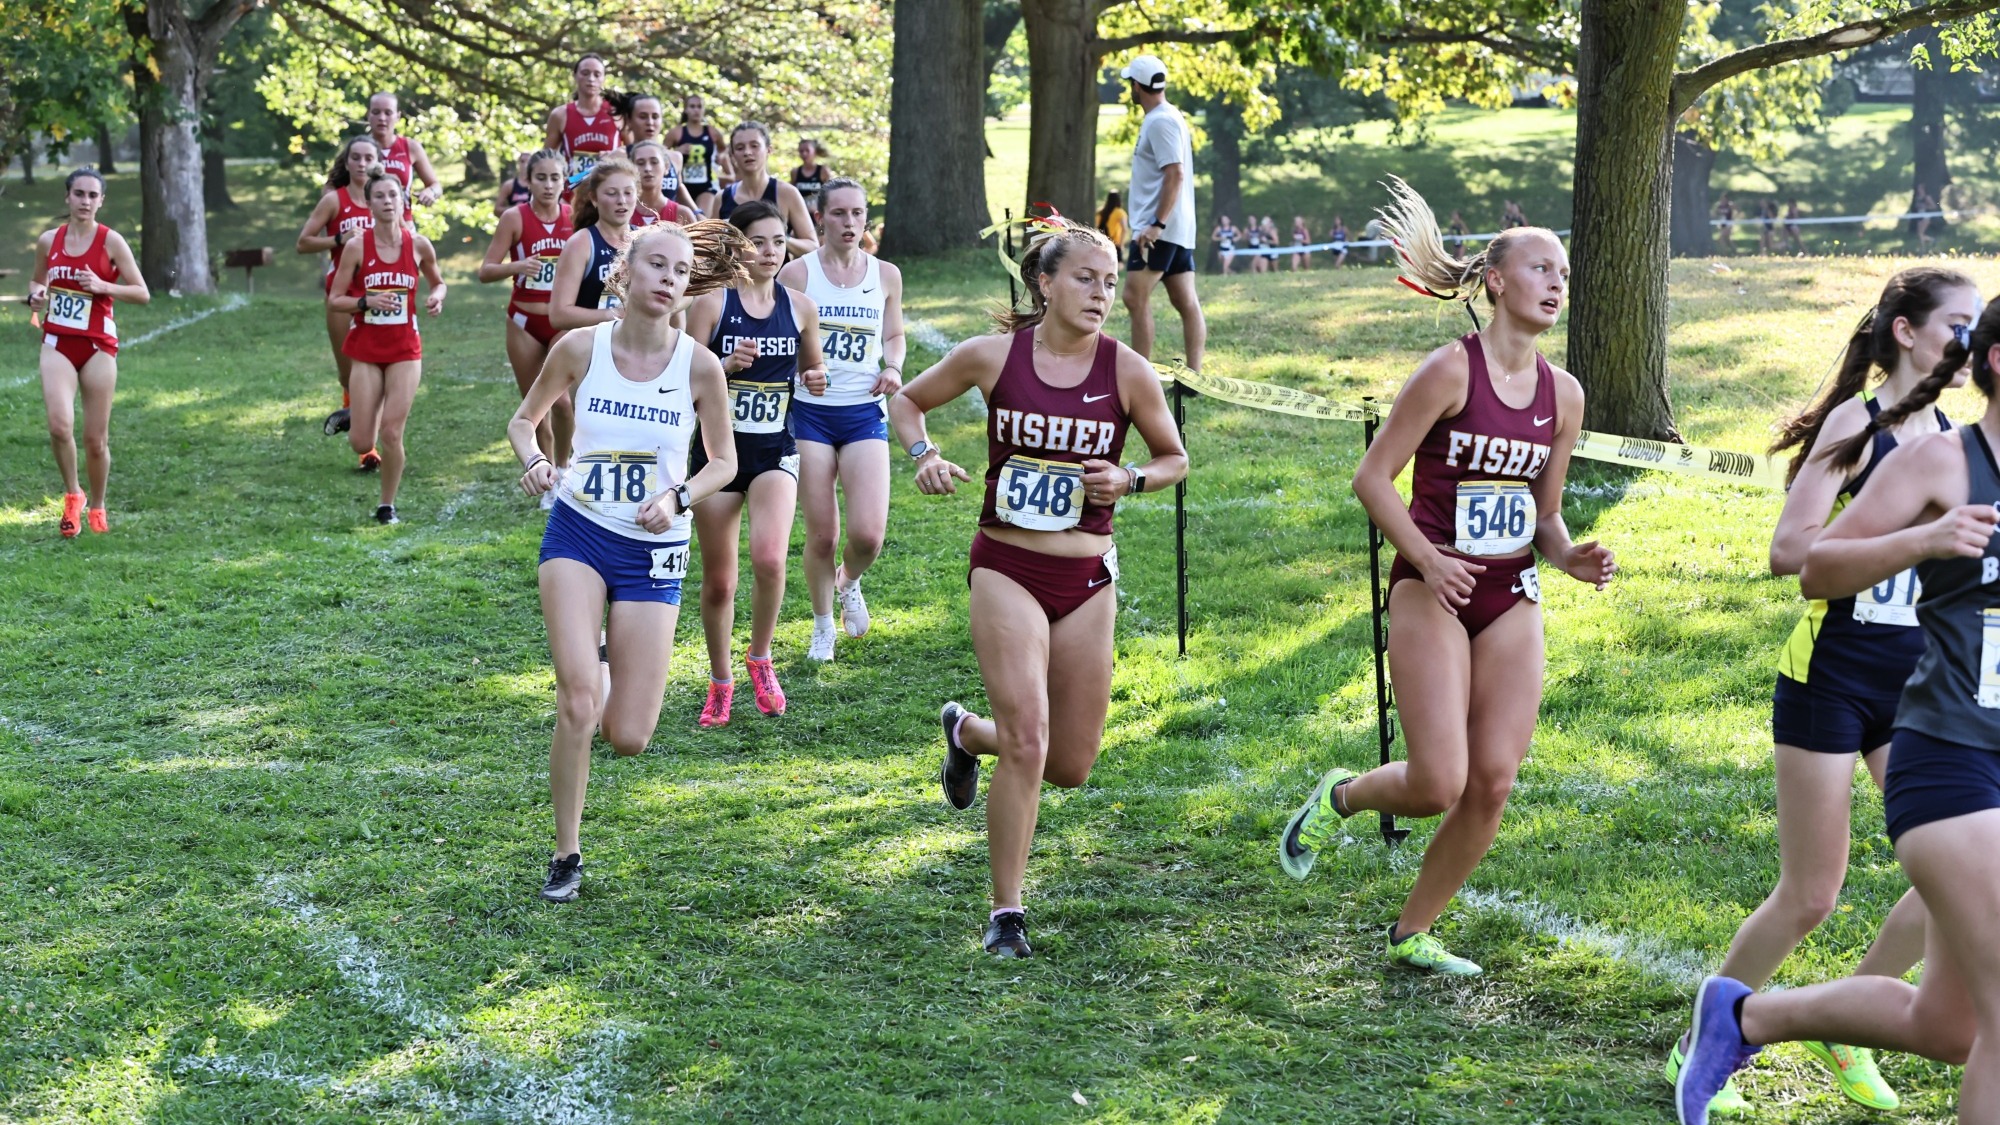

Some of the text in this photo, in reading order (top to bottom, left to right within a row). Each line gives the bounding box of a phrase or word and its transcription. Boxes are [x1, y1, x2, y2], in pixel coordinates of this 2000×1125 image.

[339, 216, 376, 233] CORTL
[531, 237, 567, 254] CORTLAN
[48, 265, 81, 281] ORTLA
[363, 271, 416, 289] CORTLAND
[53, 294, 85, 321] 392
[817, 306, 880, 320] HAMILTON
[822, 331, 867, 363] 433
[587, 397, 681, 427] HAMILTON
[734, 391, 781, 423] 563
[996, 408, 1116, 455] FISHER
[1445, 430, 1551, 480] FISHE
[1617, 437, 1666, 463] CUIDADO
[1708, 450, 1755, 477] CAUTION
[583, 463, 646, 503] 418
[1007, 469, 1074, 517] 548
[1467, 494, 1526, 539] 546
[662, 550, 689, 573] 418
